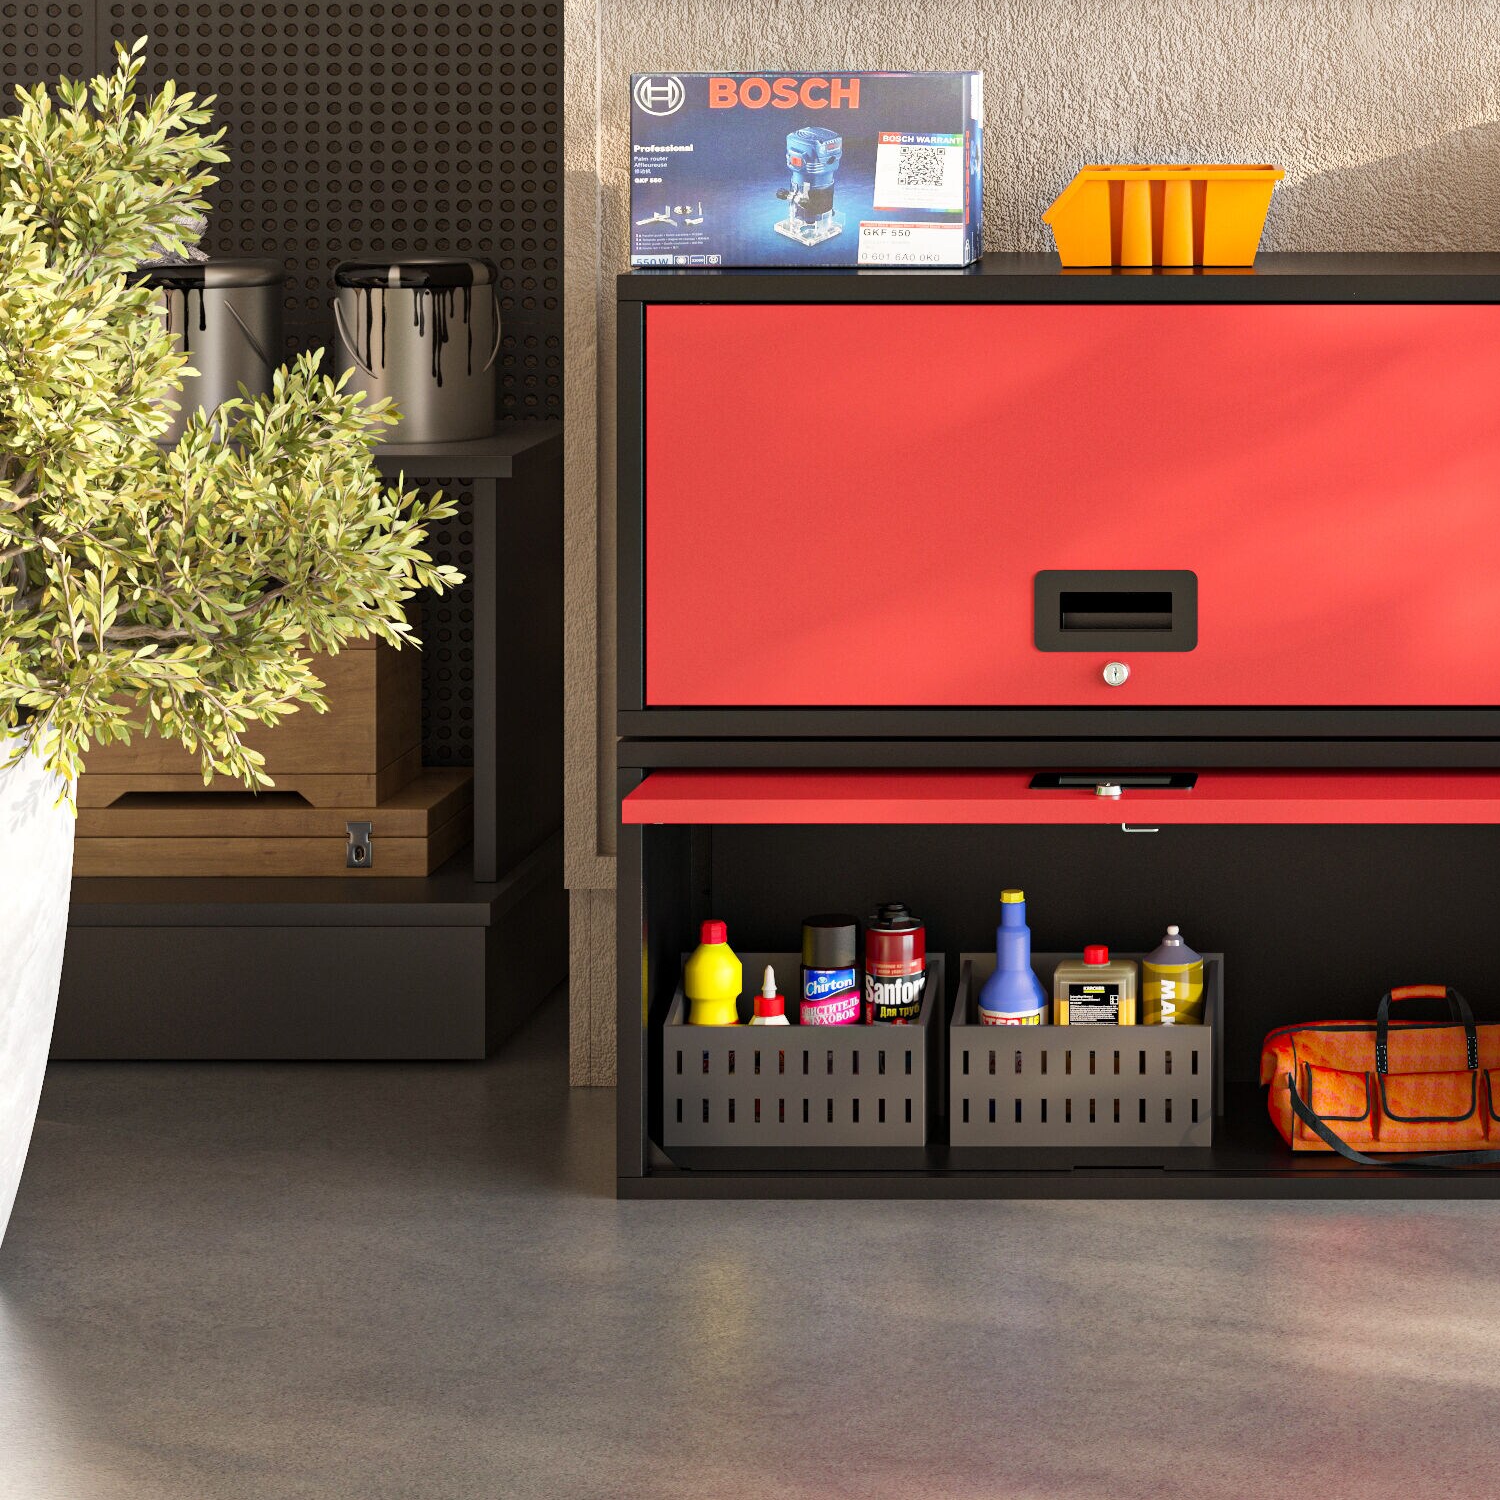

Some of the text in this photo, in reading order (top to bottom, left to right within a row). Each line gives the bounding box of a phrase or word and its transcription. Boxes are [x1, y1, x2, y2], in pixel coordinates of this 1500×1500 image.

[710, 78, 860, 109] BOSCH
[916, 136, 963, 144] WARRANT
[634, 144, 693, 152] Professional
[806, 979, 852, 996] Chirton
[880, 1007, 897, 1018] Для
